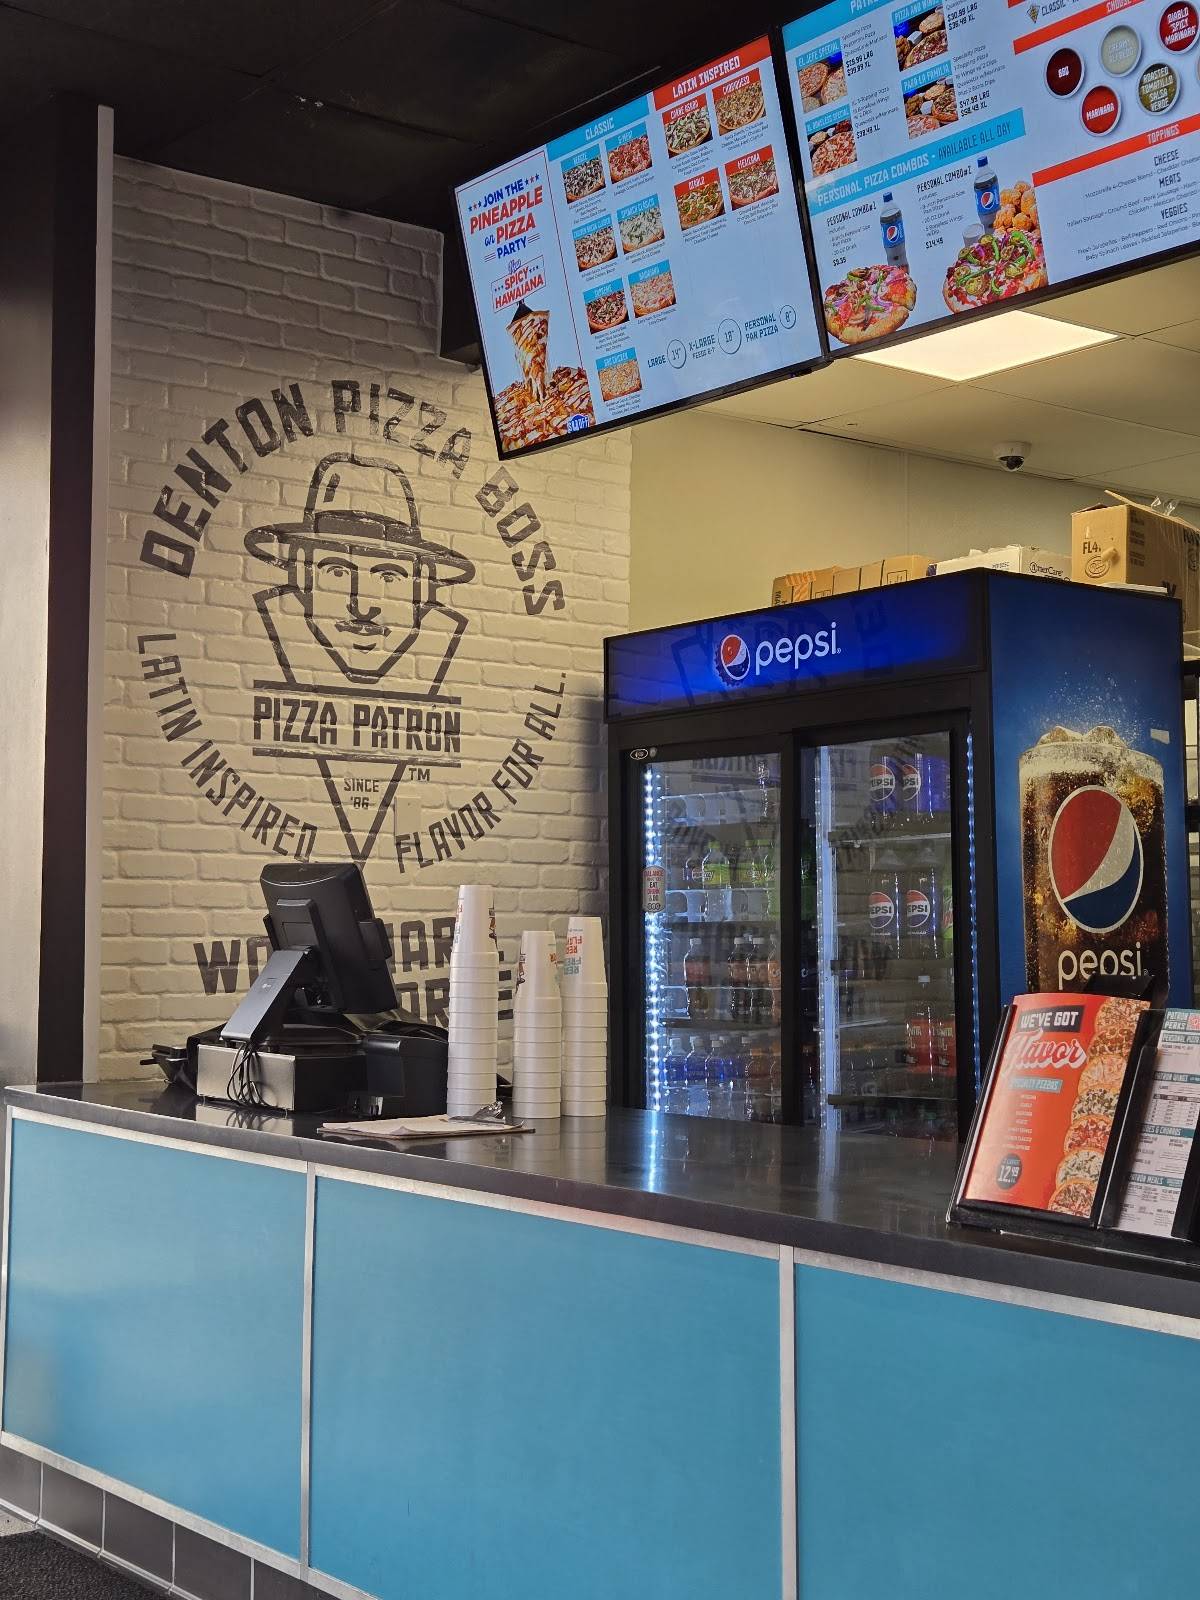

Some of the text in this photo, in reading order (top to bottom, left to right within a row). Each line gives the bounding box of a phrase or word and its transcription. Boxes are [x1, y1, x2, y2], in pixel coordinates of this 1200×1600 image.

[894, 8, 909, 22] PIZZA
[967, 2, 978, 13] LRG
[1167, 6, 1189, 23] DIABLO
[968, 13, 976, 21] XL
[1169, 18, 1188, 31] SPICY
[1165, 25, 1196, 45] MARINARA
[798, 55, 806, 66] EL
[818, 42, 839, 58] SPECIAL
[863, 50, 874, 61] LRG
[672, 55, 741, 98] LATIN INSPIRED
[926, 65, 951, 81] FAMILIA
[1058, 66, 1069, 77] BBQ
[1143, 66, 1168, 82] ROASTED
[1141, 74, 1173, 94] TOMATILLO
[979, 90, 990, 101] LRG
[1149, 89, 1168, 101] SALSA
[980, 101, 988, 110] XL
[1086, 102, 1114, 120] MARINARA
[1150, 99, 1169, 111] VERDE
[585, 117, 615, 141] CLASSIC
[1146, 123, 1180, 144] TOPPINGS
[816, 122, 1012, 207] PERSONAL PIZZA COMBOS AVAILABLE ALL DAY
[1154, 149, 1179, 166] CHEESE
[917, 177, 944, 193] PERSONAL
[1158, 172, 1181, 188] MEATS
[483, 179, 525, 208] JOIN THE
[1128, 200, 1140, 208] Beef
[1143, 195, 1156, 203] Pork
[470, 185, 544, 234] PINEAPPLE
[1160, 202, 1188, 219] VEGGIES
[496, 212, 537, 244] PIZZA
[497, 236, 527, 259] PARTY
[504, 266, 529, 291] SPICY
[495, 274, 544, 308] HAWAIANA
[744, 313, 776, 331] PERSONAL
[688, 334, 717, 351] X-LARGE
[745, 325, 779, 343] PAN PIZZA
[647, 356, 667, 368] LARGE
[140, 379, 566, 615] DENTON PIZZA BOSS
[756, 621, 837, 676] pepsi
[253, 696, 338, 745] PIZZA
[137, 633, 202, 743] LATIN
[180, 738, 318, 864] INSPIRED
[394, 790, 502, 873] FLAVOR
[492, 738, 545, 805] FOR
[408, 768, 431, 781] TM
[343, 777, 380, 794] SINCE
[1057, 942, 1144, 991] pepsi
[1020, 1011, 1079, 1029] WE'VE GOT
[1165, 1021, 1187, 1030] PERKS
